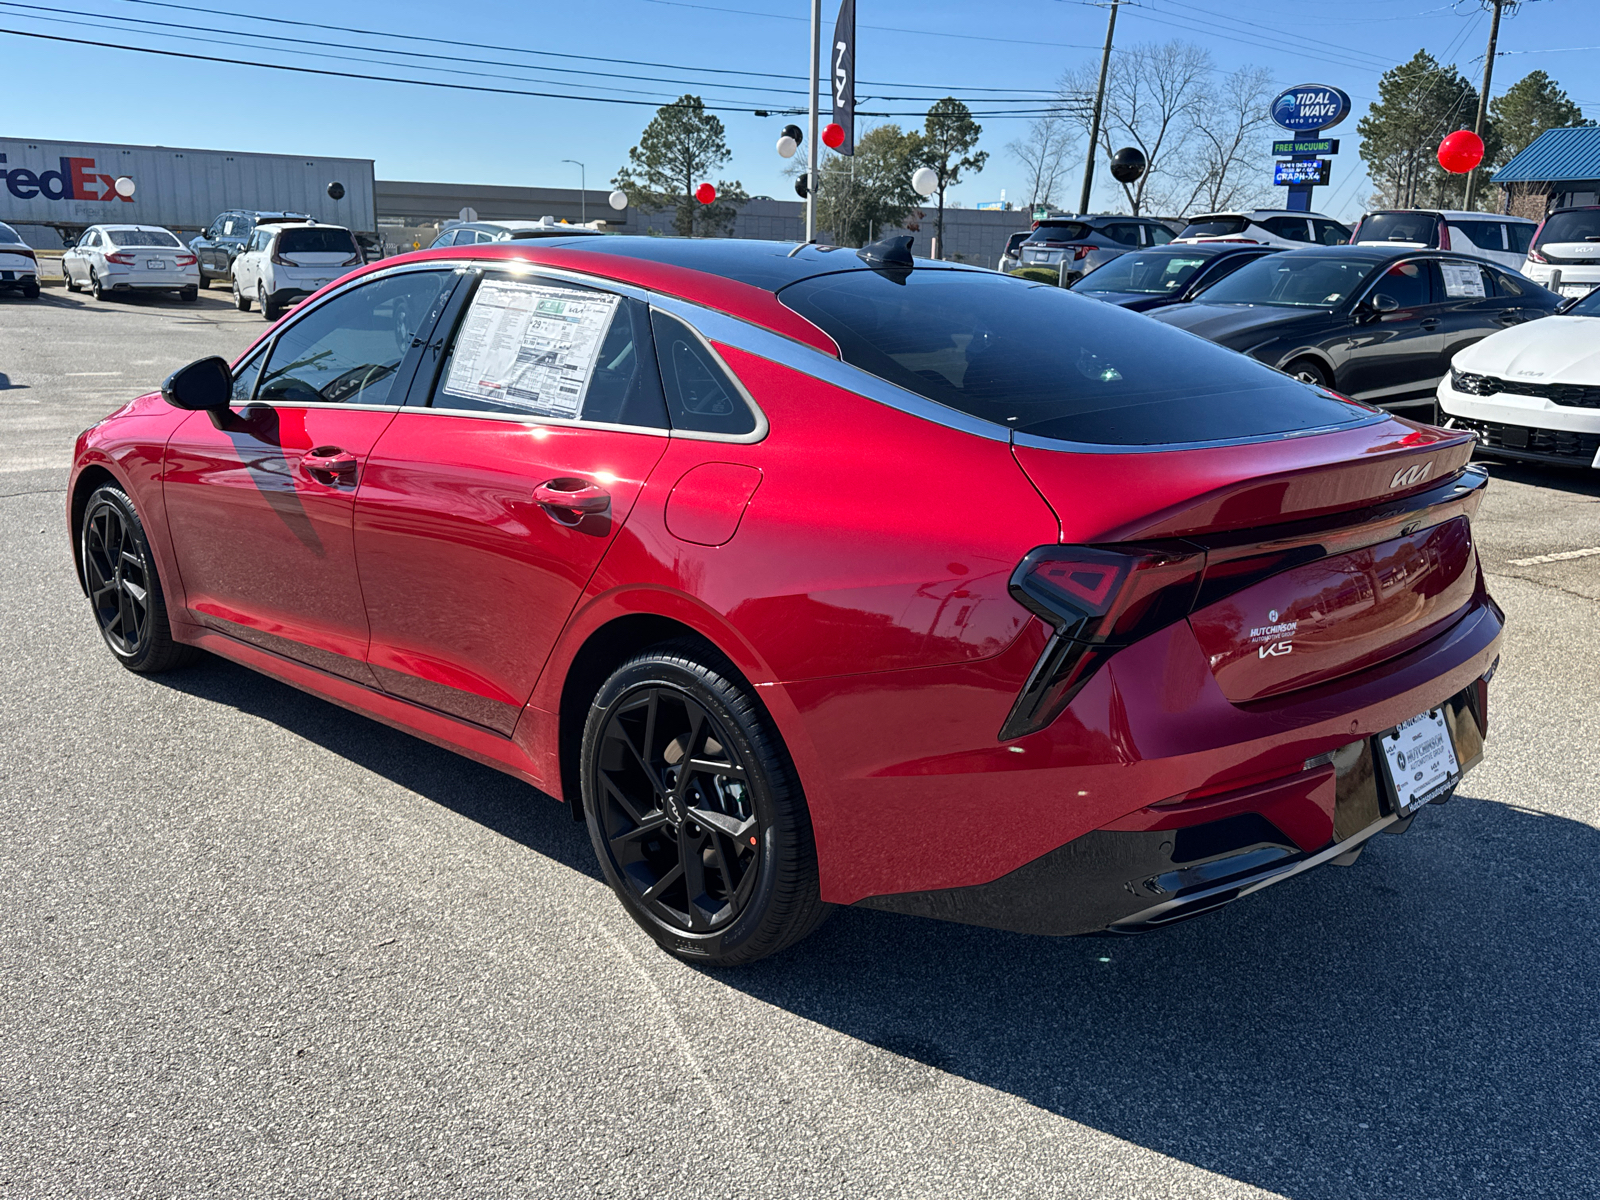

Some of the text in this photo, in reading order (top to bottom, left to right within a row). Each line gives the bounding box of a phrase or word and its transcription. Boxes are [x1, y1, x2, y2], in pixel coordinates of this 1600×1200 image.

[1296, 92, 1330, 104] TIDAL
[1300, 104, 1337, 117] WAVE
[1275, 142, 1329, 152] FREE VACUUMS
[1389, 461, 1433, 488] KIA
[1250, 622, 1297, 637] HUTCHINSON
[1252, 634, 1281, 643] AUTOMOTIVE
[1259, 640, 1292, 659] K5
[1406, 732, 1444, 764] HUTCHINSON
